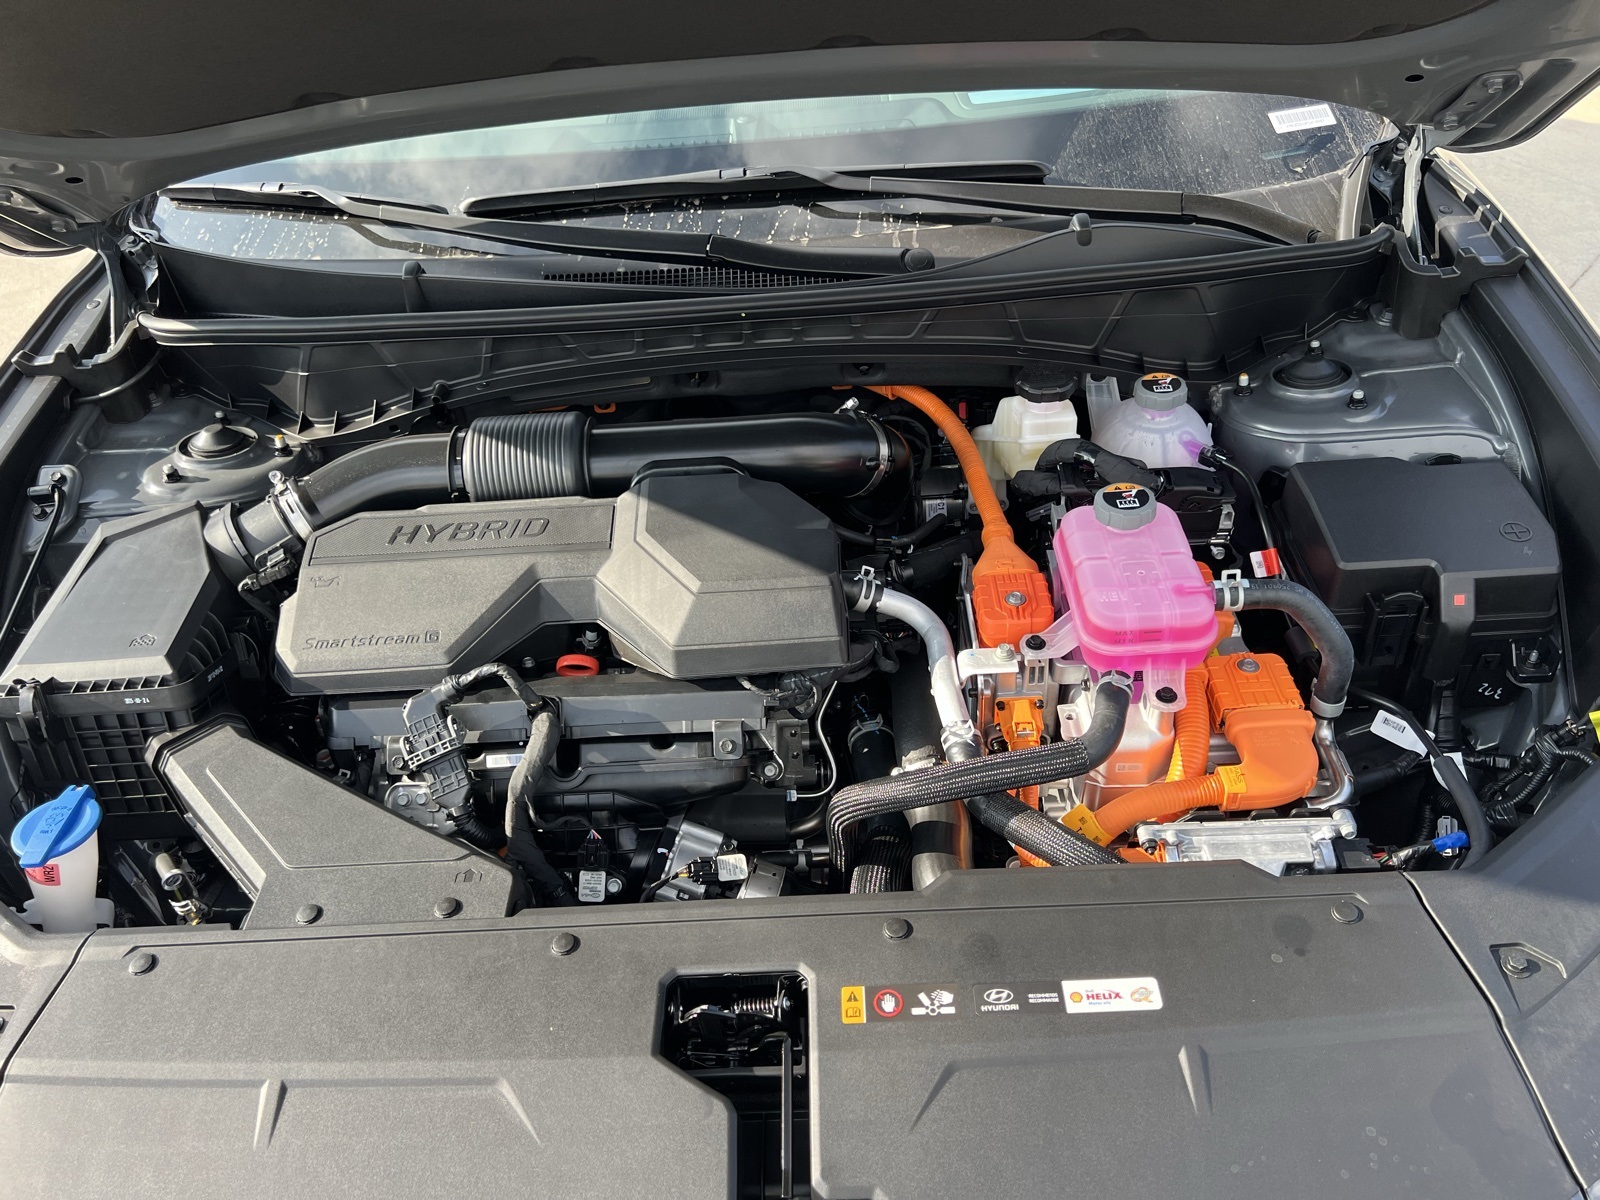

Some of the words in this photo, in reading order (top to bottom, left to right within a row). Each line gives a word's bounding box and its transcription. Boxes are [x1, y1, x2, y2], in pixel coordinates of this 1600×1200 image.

[385, 517, 550, 546] HYBRID
[302, 634, 421, 650] Smartstream
[43, 865, 55, 883] WR2
[1086, 991, 1123, 1001] HELIX
[980, 1004, 1019, 1012] HYUNDAI
